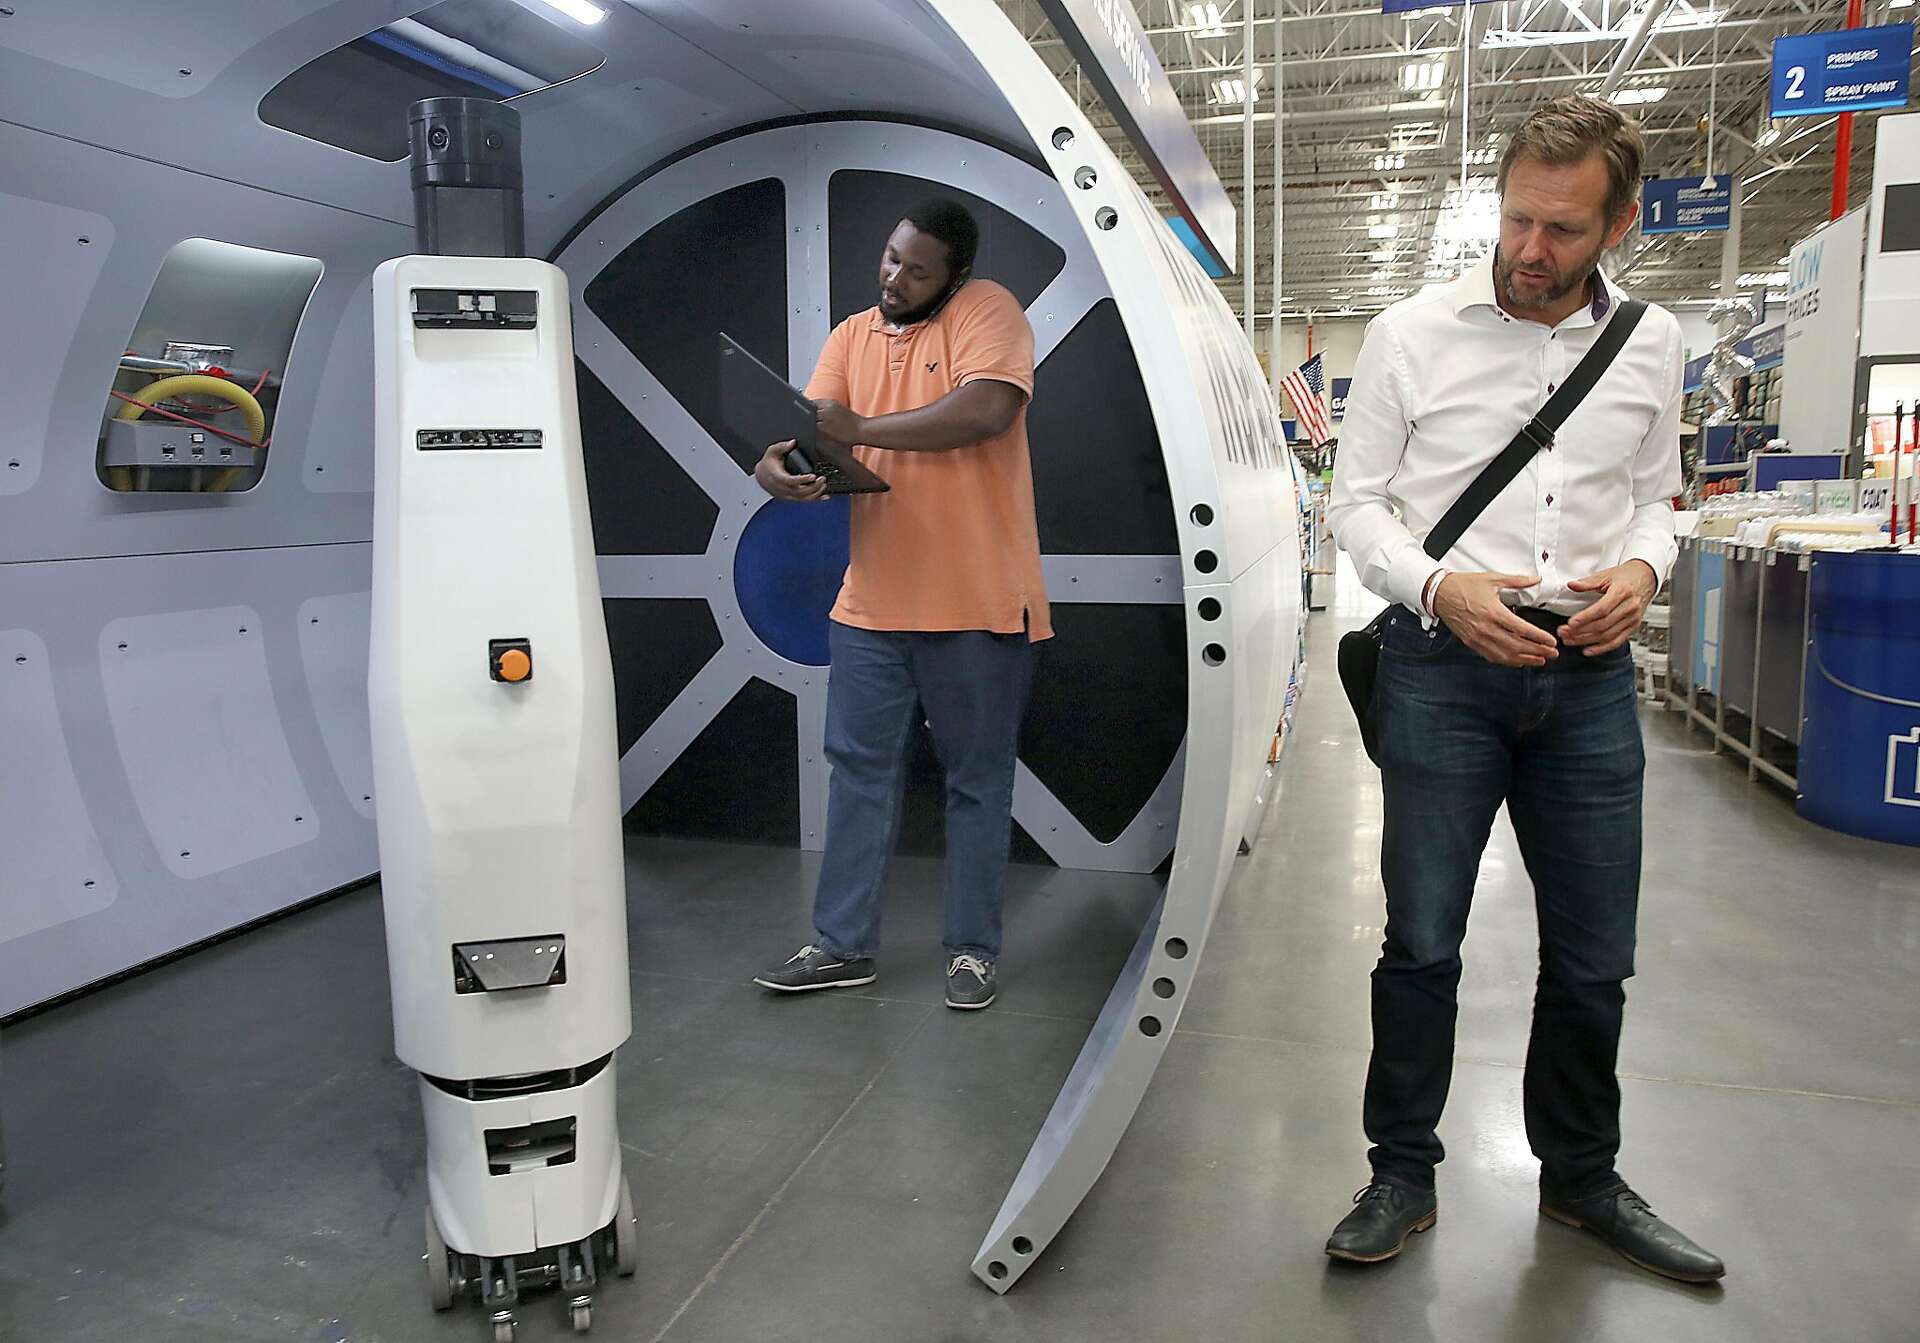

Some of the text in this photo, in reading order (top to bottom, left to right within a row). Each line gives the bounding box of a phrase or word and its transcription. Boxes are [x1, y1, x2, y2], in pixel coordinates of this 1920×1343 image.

[1826, 48, 1879, 65] PRIMERS
[1784, 66, 1806, 100] 2
[1824, 80, 1899, 98] SPRAY PAINT
[1651, 200, 1662, 223] 1
